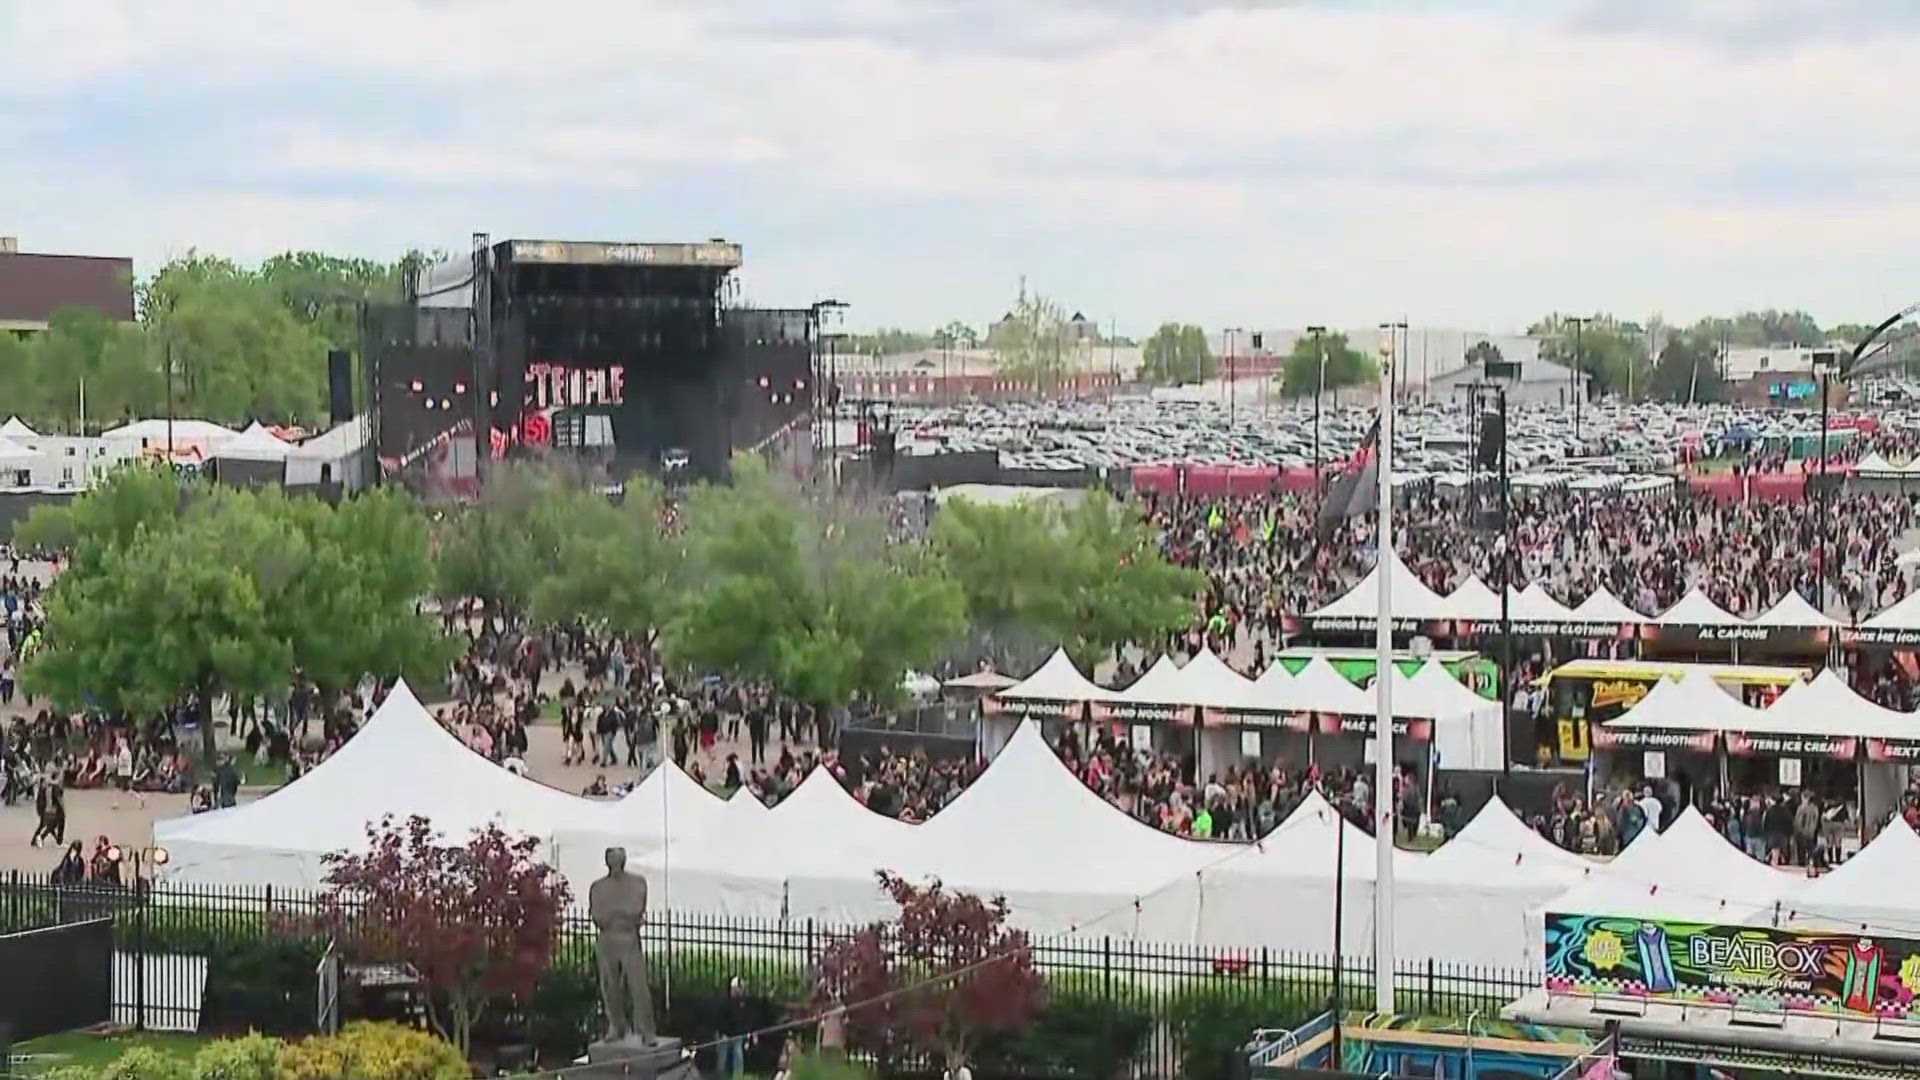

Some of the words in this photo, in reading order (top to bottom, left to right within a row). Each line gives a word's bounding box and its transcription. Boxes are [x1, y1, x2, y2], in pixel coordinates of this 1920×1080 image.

[1470, 623, 1506, 634] LITTL
[1510, 623, 1557, 635] ROCKER
[1560, 623, 1618, 636] CLOTHING
[1698, 627, 1715, 640] AL
[1717, 628, 1769, 640] CAPONE
[1738, 738, 1780, 751] AFTERS
[1782, 740, 1802, 752] ICE
[1803, 741, 1845, 753] CREAM
[1692, 935, 1823, 976] BEATBOX
